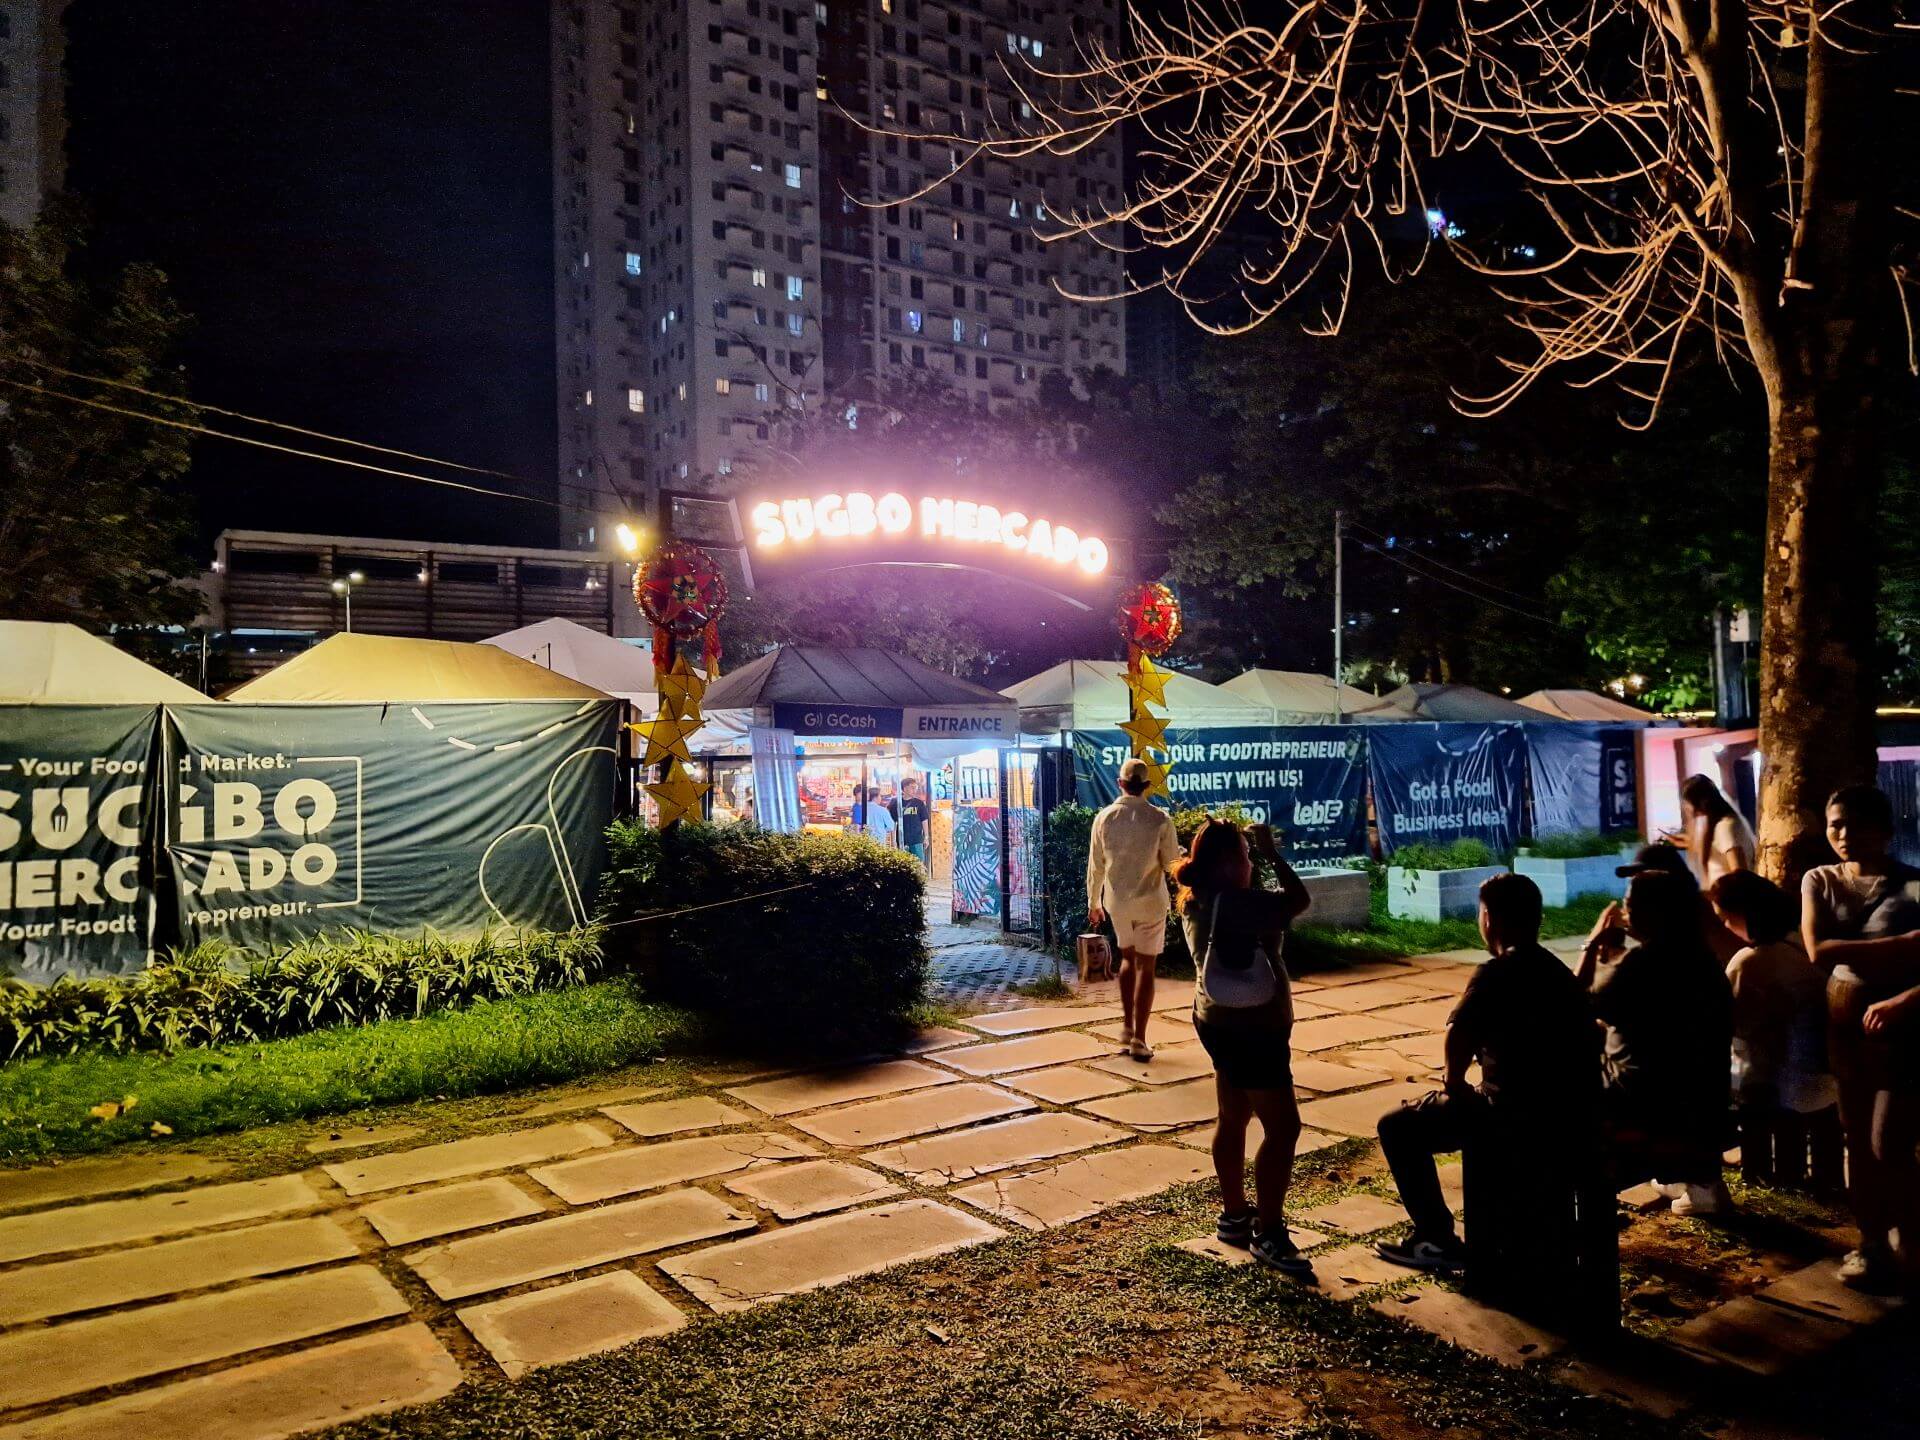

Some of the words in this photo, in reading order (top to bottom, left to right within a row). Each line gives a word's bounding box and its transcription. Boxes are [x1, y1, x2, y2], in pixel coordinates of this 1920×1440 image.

[753, 492, 912, 546] SUGBO
[919, 496, 1108, 574] MERCADO
[827, 713, 876, 728] GCash
[918, 716, 1002, 732] ENTRANCE
[1163, 743, 1205, 763] YOUR
[1209, 741, 1346, 762] FOODTREPRENEUR
[19, 757, 84, 777] Your
[201, 752, 291, 772] Market.
[1166, 771, 1237, 792] OURNEY
[1236, 770, 1276, 789] WITH
[1279, 769, 1304, 788] US!
[1409, 780, 1437, 801] Got
[1441, 785, 1451, 799] a
[1454, 777, 1492, 799] Food
[1393, 811, 1464, 834] Business
[1467, 807, 1507, 827] Idea?
